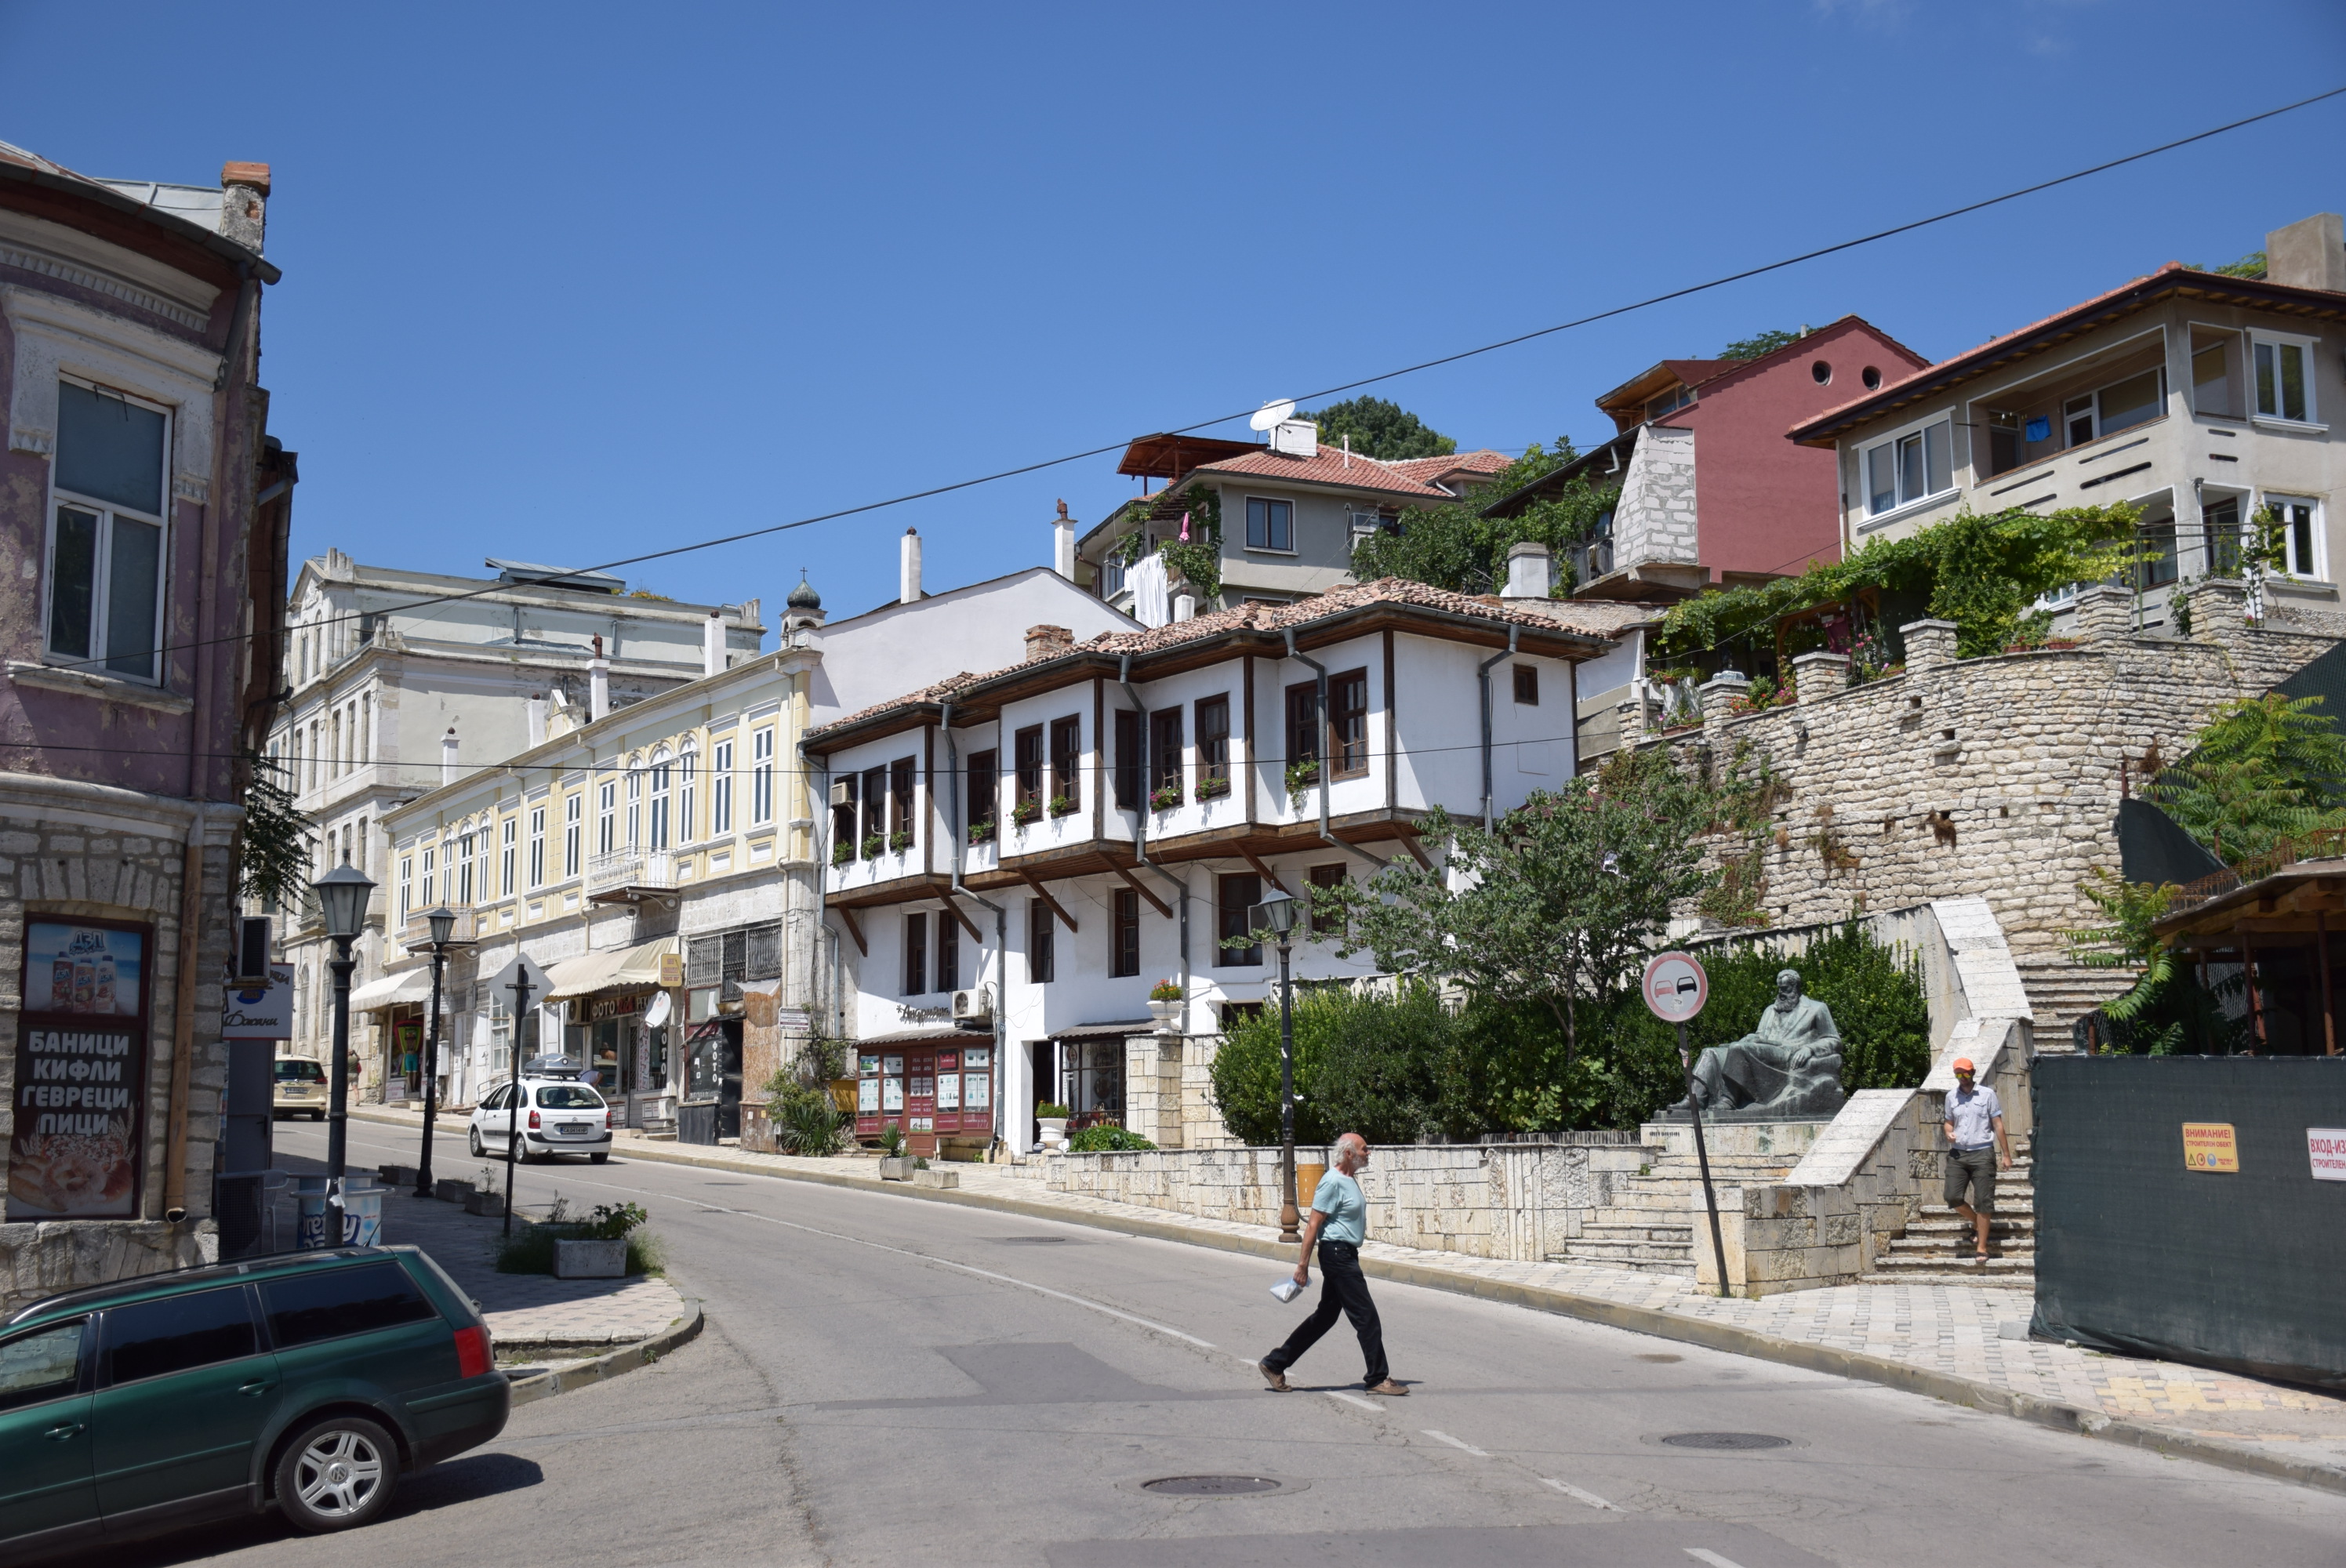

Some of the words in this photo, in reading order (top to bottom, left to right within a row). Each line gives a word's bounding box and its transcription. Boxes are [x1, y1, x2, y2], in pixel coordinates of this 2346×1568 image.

[592, 1000, 616, 1018] ФОТО
[28, 1031, 129, 1058] БАНИЦИ
[33, 1058, 122, 1082] КИФЛИ
[22, 1085, 129, 1111] ГЕВРЕЦИ
[39, 1113, 109, 1137] ПИЦИ
[2185, 1128, 2231, 1138] ВНИМАНИЕ!
[2310, 1138, 2346, 1156] ВХОД-ИЗ
